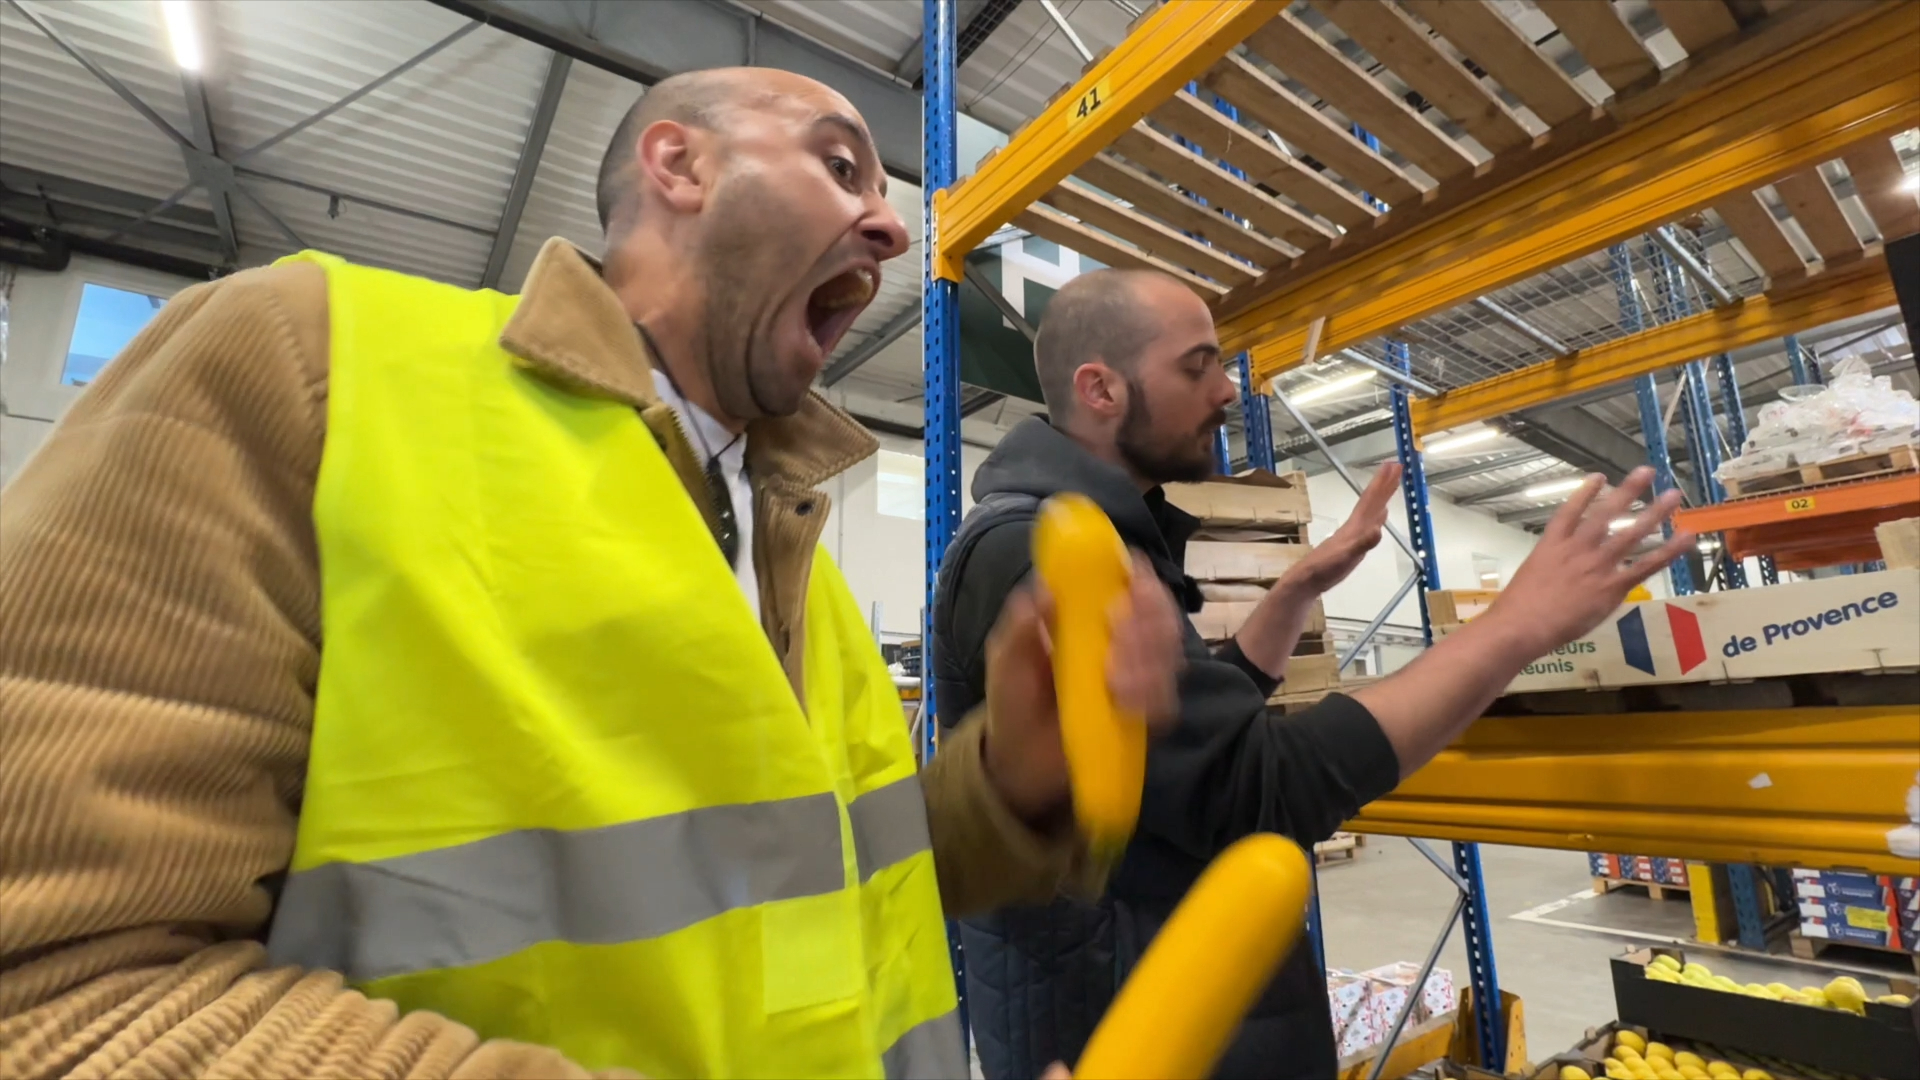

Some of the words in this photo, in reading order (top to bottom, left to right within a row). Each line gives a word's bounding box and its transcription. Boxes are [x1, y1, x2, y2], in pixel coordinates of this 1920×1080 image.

[1076, 86, 1101, 118] 41
[1791, 498, 1808, 510] 02
[1722, 634, 1757, 658] de
[1761, 590, 1899, 646] Provence
[1519, 658, 1574, 676] eunis
